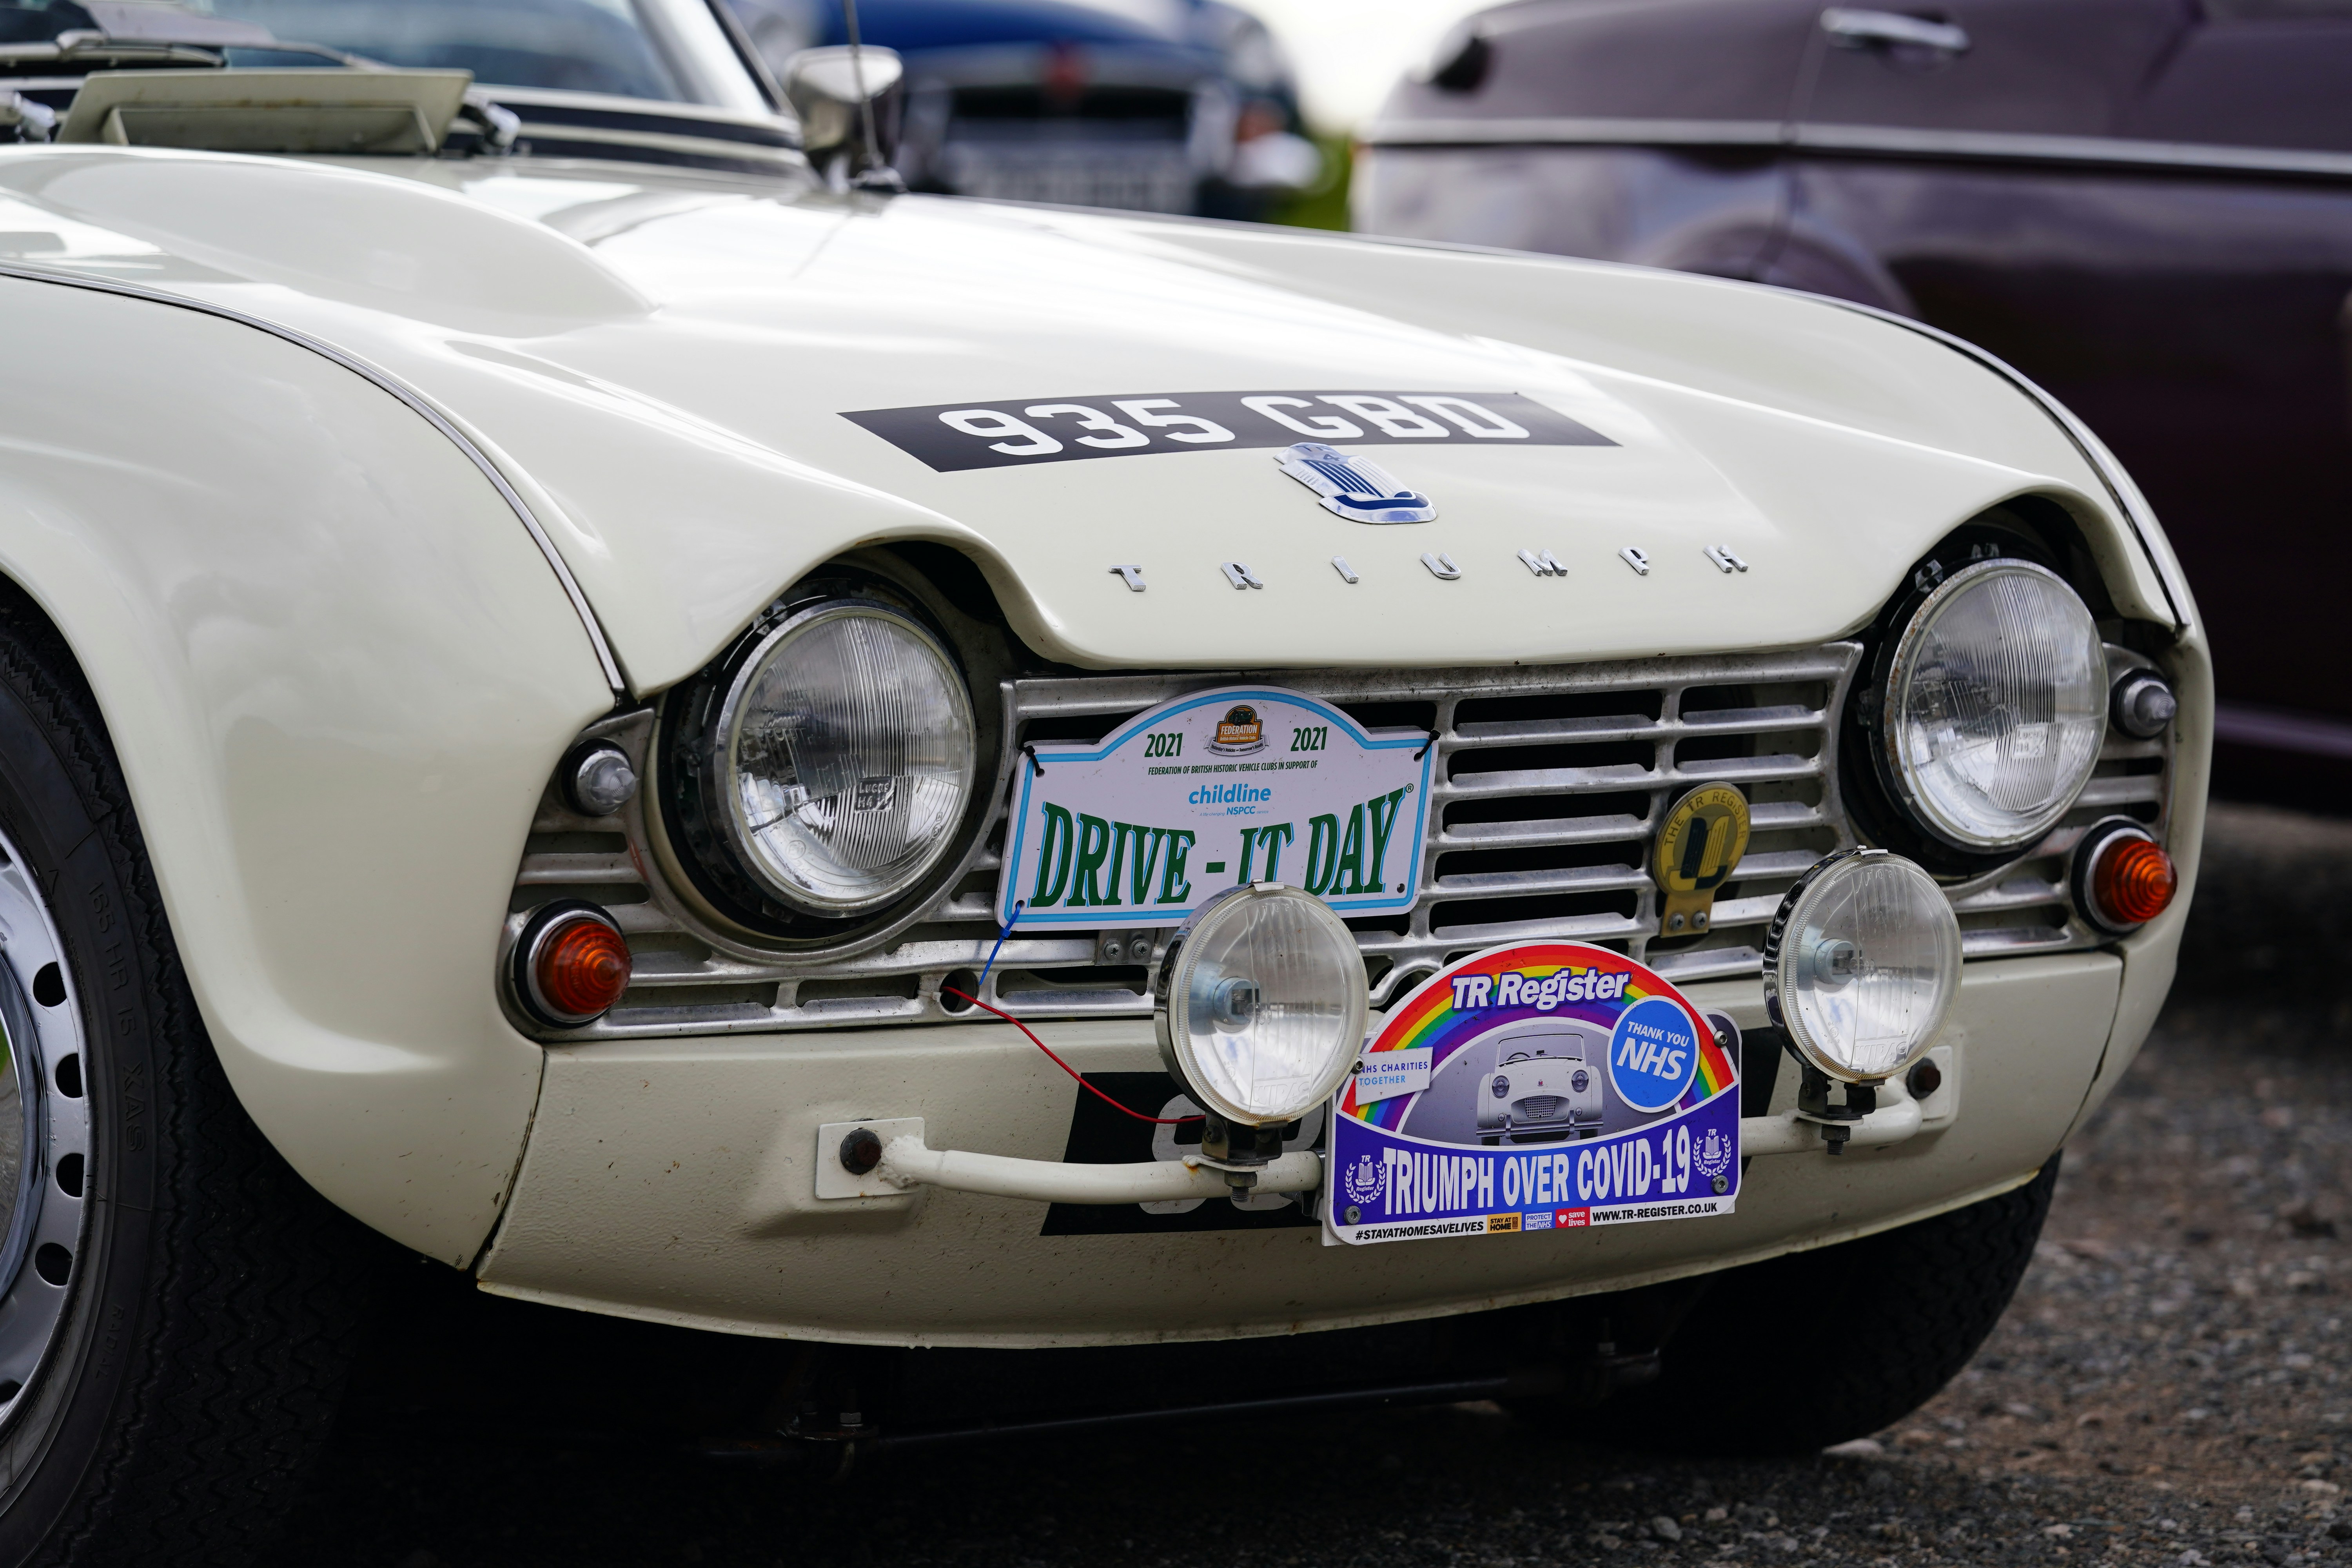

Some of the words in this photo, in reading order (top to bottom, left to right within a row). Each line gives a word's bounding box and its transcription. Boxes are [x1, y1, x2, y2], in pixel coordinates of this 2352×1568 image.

[938, 399, 1237, 456] 935
[1240, 393, 1532, 439] GBD
[1108, 544, 1749, 592] TRIUMPH
[1221, 725, 1258, 735] FEDERATION
[1290, 726, 1327, 751] 2021
[1144, 733, 1183, 757] 2021
[1148, 766, 1181, 775] FEDERATION
[1183, 766, 1190, 774] OF
[1191, 765, 1212, 774] BRITISH
[1214, 764, 1237, 773] HISTORIC
[1239, 762, 1259, 771] VEHICLE
[1261, 762, 1277, 771] CLUBS
[1278, 762, 1284, 770] IN
[1285, 760, 1309, 769] SUPPORT
[1310, 760, 1318, 768] OF
[1189, 784, 1271, 804] childline
[1227, 806, 1256, 815] NSPCC
[1664, 815, 1684, 846] THE
[1686, 797, 1704, 811] TR
[1712, 791, 1746, 839] REGISTER
[1028, 802, 1195, 907] DRIVE
[1238, 822, 1294, 884] IT
[88, 881, 115, 933] 165
[105, 941, 129, 991] HR
[1453, 976, 1492, 1009] TR
[1497, 968, 1630, 1010] Register
[117, 1005, 137, 1036] 15
[1628, 1021, 1665, 1041] THANK
[1667, 1031, 1690, 1047] YOU
[1381, 1062, 1428, 1072] CHARITIES
[1616, 1037, 1687, 1080] NHS
[1359, 1075, 1405, 1085] TOGETHER
[123, 1060, 145, 1152] XAS
[1383, 1147, 1494, 1215] TRIUMPH
[1503, 1155, 1569, 1207] OVER
[1577, 1124, 1691, 1200] COVID-19
[1538, 1220, 1552, 1229] NHS
[1568, 1218, 1586, 1227] lives
[1592, 1202, 1718, 1222] WWW.TR-REGISTER.CO.UK
[1355, 1221, 1484, 1241] #STAYATHOMESAVELIVES
[95, 1305, 124, 1378] RADIAL
